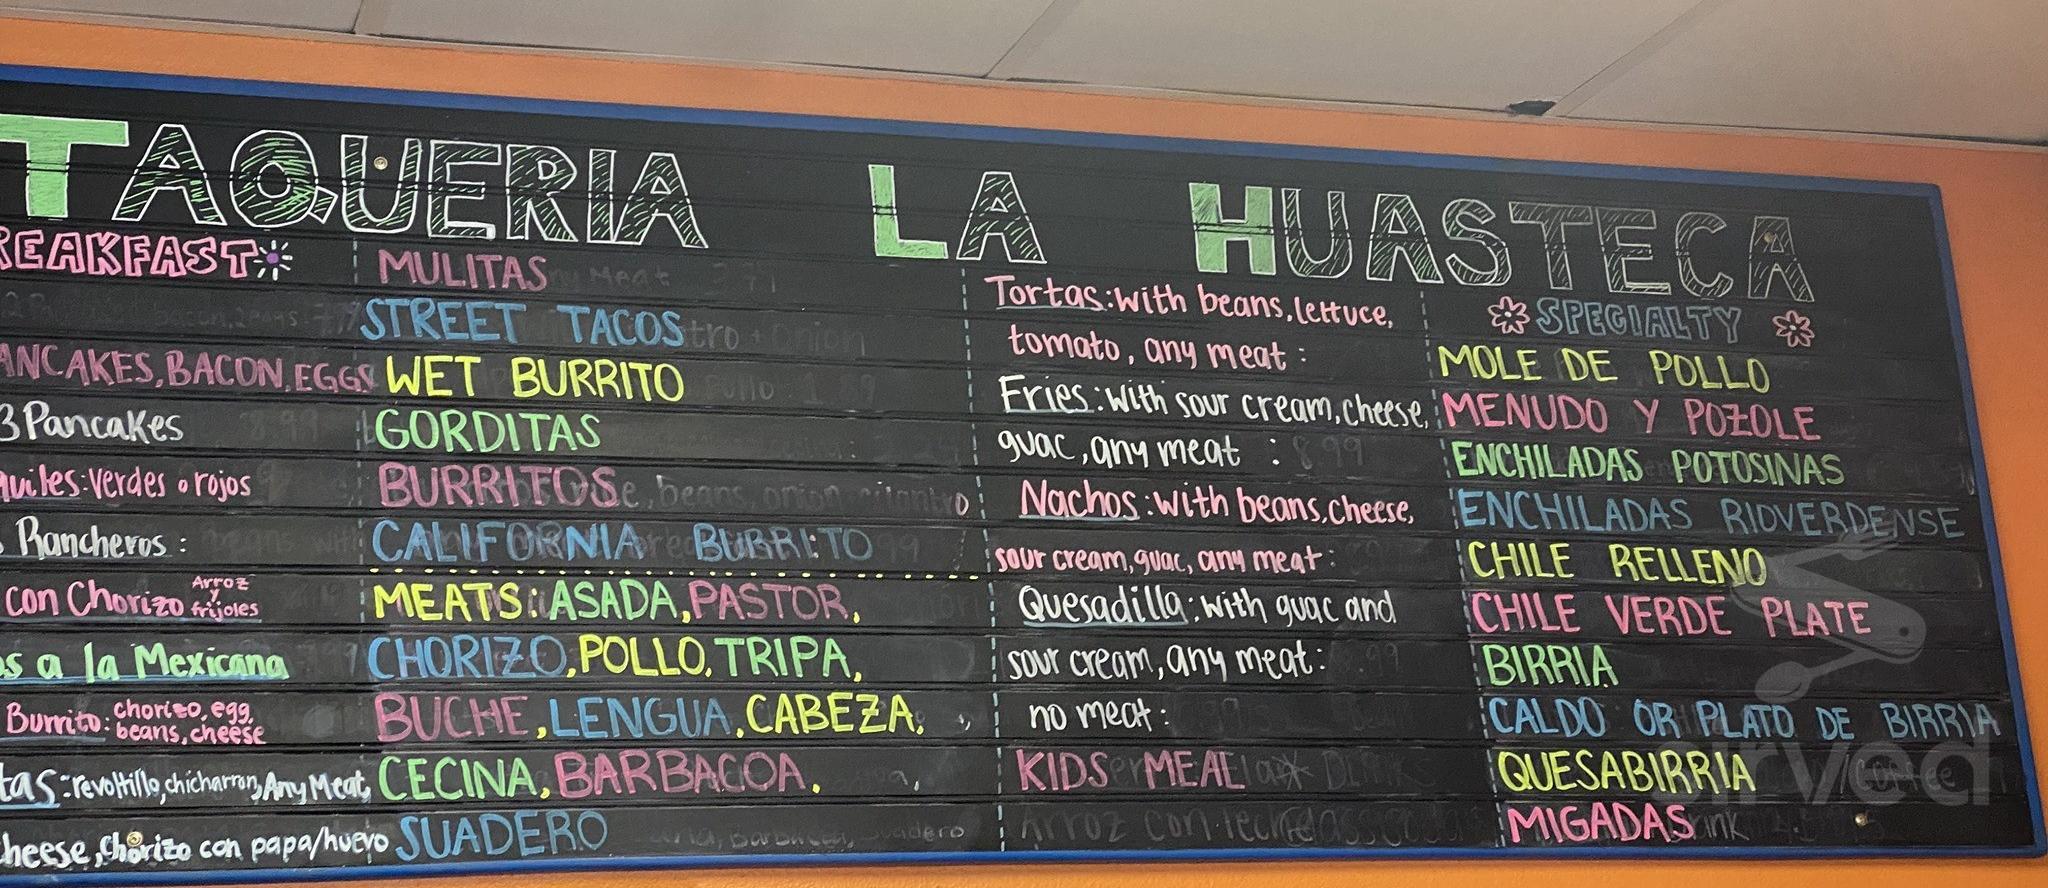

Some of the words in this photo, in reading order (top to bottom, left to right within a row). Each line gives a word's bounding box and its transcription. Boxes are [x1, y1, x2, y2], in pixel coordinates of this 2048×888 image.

[0, 112, 708, 249] TAQUERIA
[868, 163, 1048, 264] LA
[1188, 182, 1815, 304] HUASTECA
[379, 248, 548, 292] MULITAS
[1113, 285, 1187, 315] with
[1536, 297, 1743, 344] SPECIALTY
[360, 299, 528, 344] STREET
[556, 305, 686, 348] TACOS
[1144, 336, 1198, 371] any
[1436, 344, 1543, 382] MOLE
[1560, 348, 1618, 383] DE
[1649, 348, 1771, 395] POLLO
[386, 355, 482, 398] WET
[512, 357, 685, 402] BURRITO
[1104, 378, 1166, 415] with
[1176, 386, 1229, 418] sour
[23, 400, 184, 444] Pancakes
[375, 409, 602, 453] GORDITAS
[1442, 392, 1609, 435] MENUDO
[1632, 397, 1661, 435] Y
[1682, 398, 1823, 443] POZOLE
[1088, 435, 1150, 470] any
[1450, 440, 1645, 484] ENCHILADAS
[1669, 447, 1848, 488] POTOSINAS
[193, 470, 252, 502] rojos
[379, 462, 620, 508] BURRITOS
[1153, 480, 1230, 516] with
[1456, 488, 1693, 533] ENCHILADAS
[372, 519, 645, 563] CALIFORNIA
[692, 522, 873, 566] BURRITO
[994, 547, 1047, 573] sour
[1197, 547, 1246, 574] any
[1467, 540, 1576, 580] CHILE
[1607, 542, 1768, 587] RELLENO
[5, 585, 59, 617] con
[67, 579, 184, 617] Chorizo
[192, 575, 250, 591] Arroz
[374, 583, 540, 623] MEATS:
[1200, 586, 1268, 624] with
[1274, 598, 1340, 629] guac
[1345, 587, 1398, 625] and
[1470, 590, 1580, 635] CHILE
[1602, 595, 1733, 636] VERDE
[1760, 599, 1872, 639] PLATE
[37, 653, 64, 679] a
[84, 642, 121, 683] la
[133, 643, 291, 681] Mexicana
[1006, 648, 1060, 682] sour
[1165, 643, 1228, 684] any
[1482, 642, 1619, 687] BIRRIA
[1028, 704, 1068, 733] no
[1488, 695, 1609, 741] CALDO
[1633, 698, 1683, 740] OR
[1698, 698, 1796, 740] PLATO
[1815, 706, 1856, 741] DE
[1880, 701, 2001, 741] BIRRIA
[1015, 749, 1110, 791] KIDS
[1142, 748, 1246, 791] MEAL
[1497, 748, 1758, 795] QUESABIRRIA
[395, 811, 608, 861] SUADERO
[1506, 800, 1697, 844] MIGADAS
[199, 838, 243, 859] con
